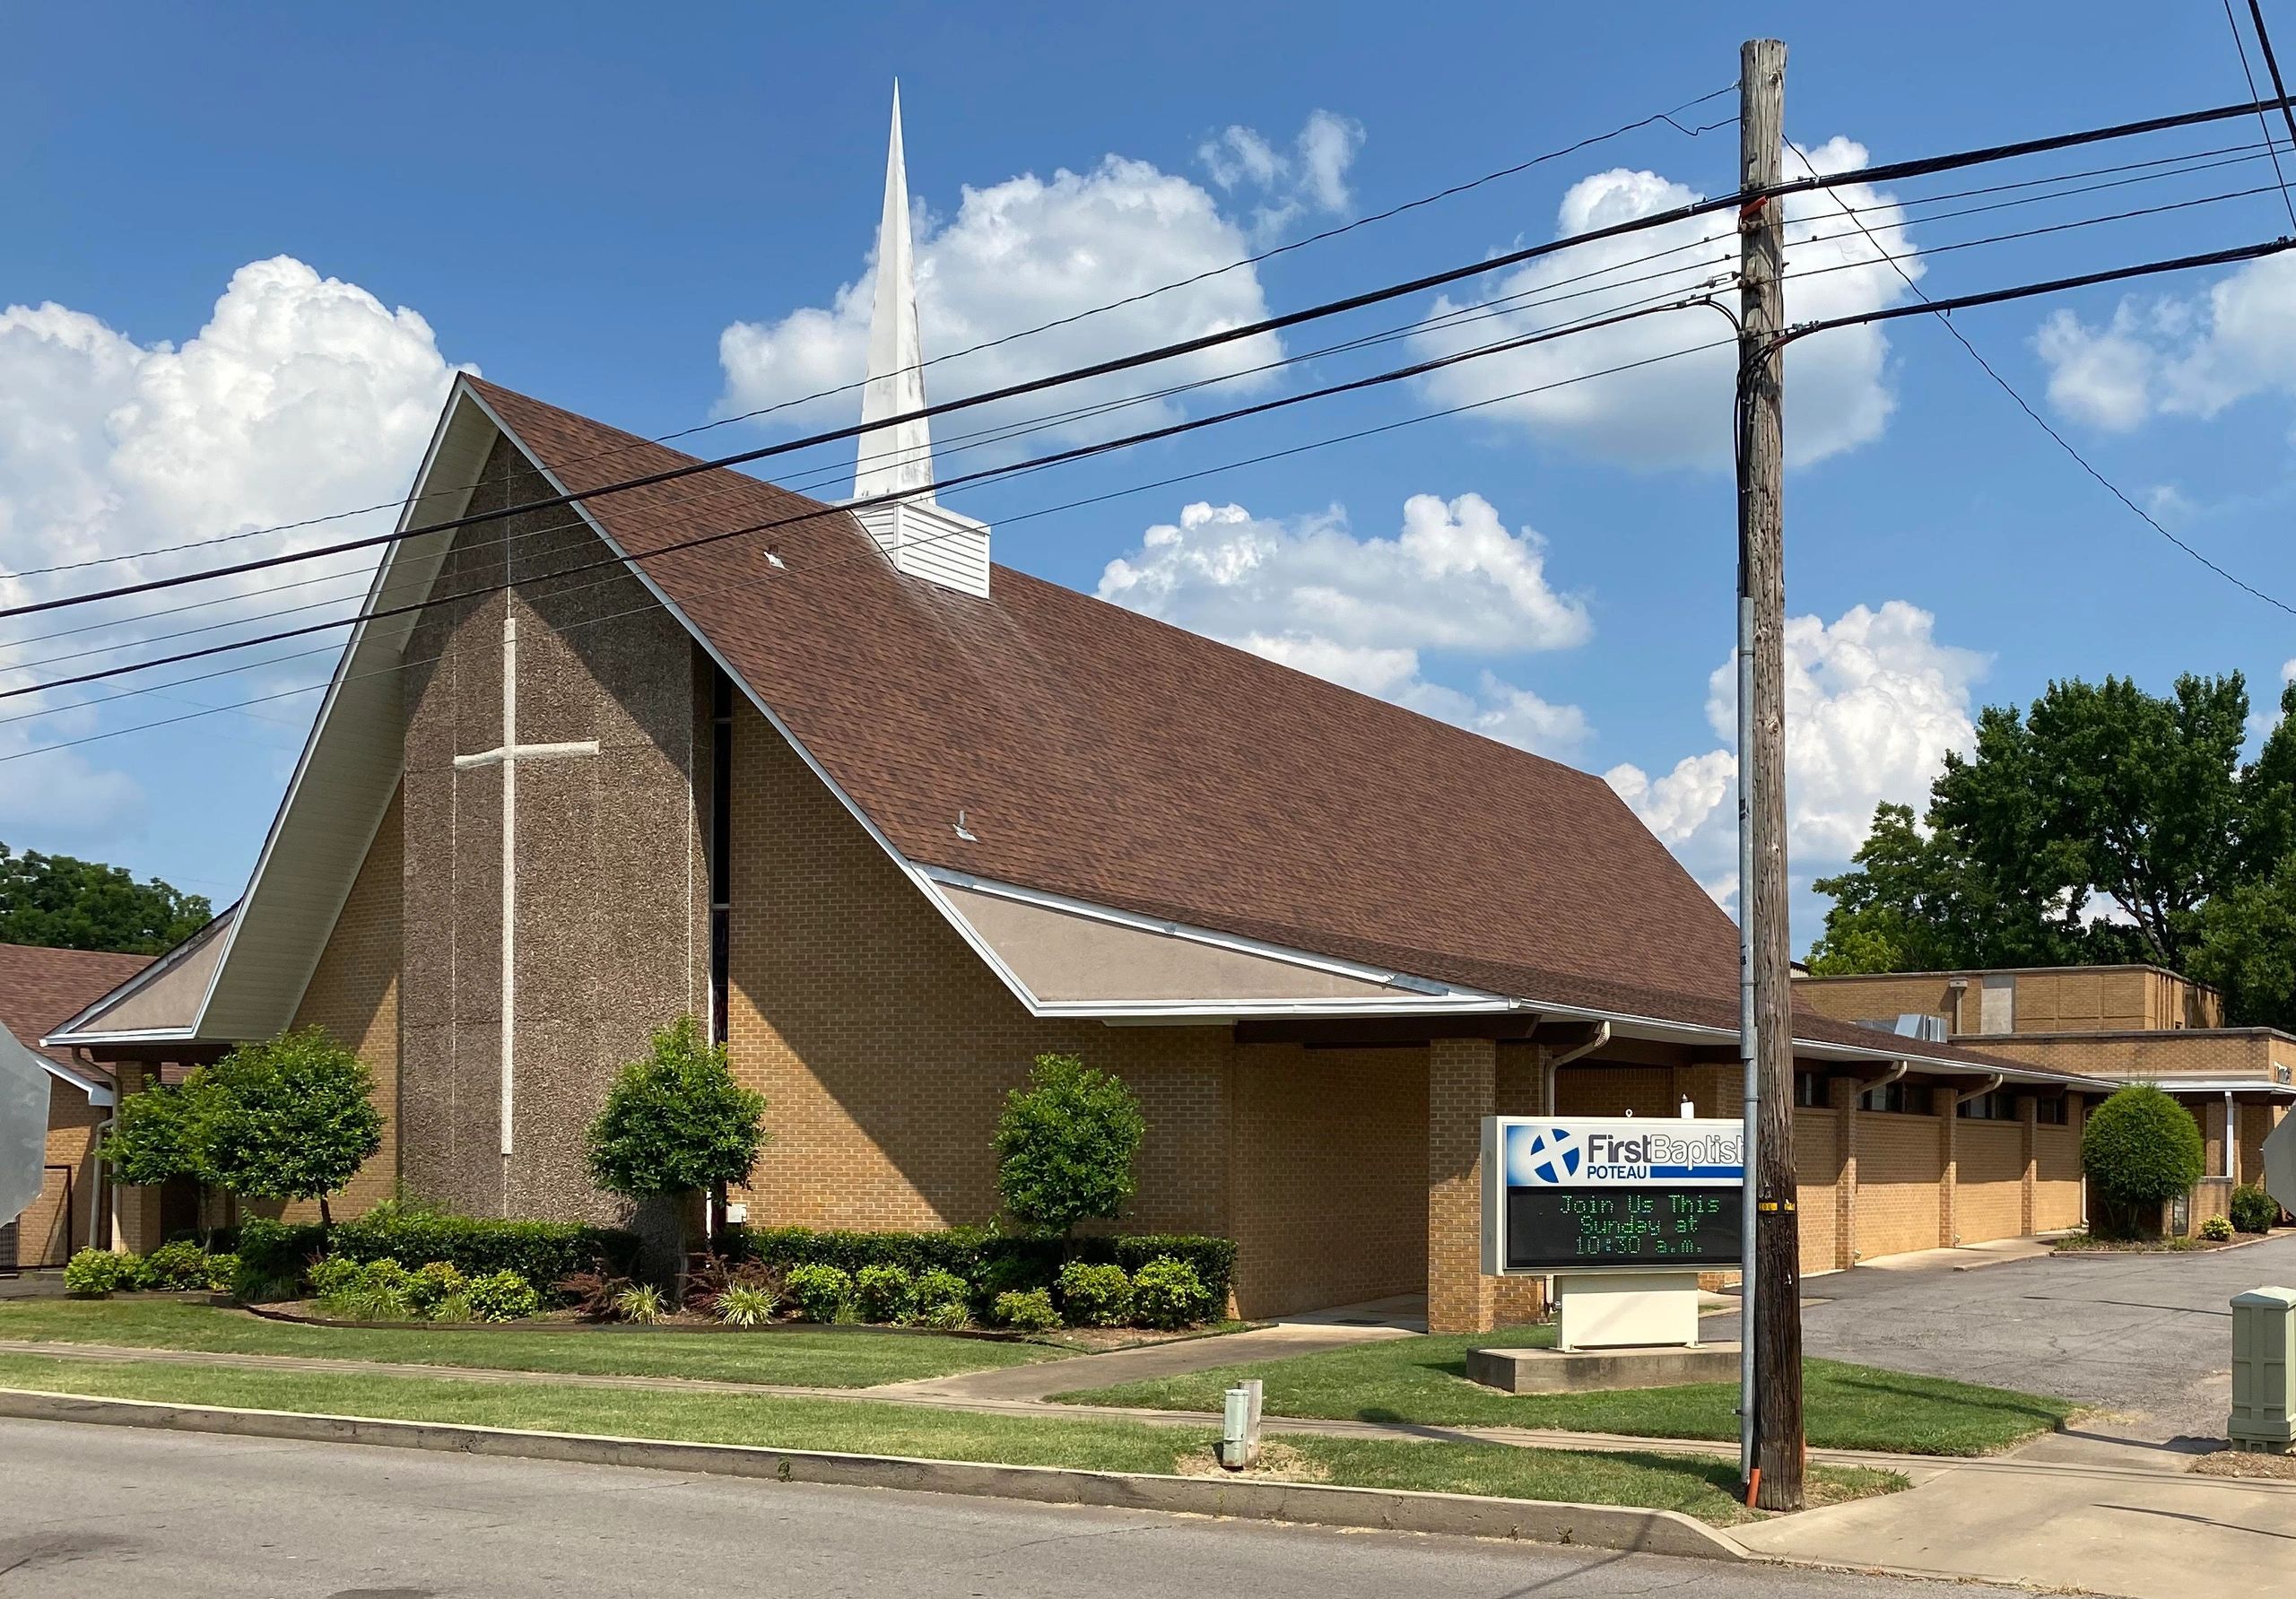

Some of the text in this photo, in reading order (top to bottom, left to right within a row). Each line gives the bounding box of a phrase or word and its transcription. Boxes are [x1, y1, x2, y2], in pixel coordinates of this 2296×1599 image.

[1587, 1134, 1744, 1171] FirstBaptist
[1587, 1165, 1648, 1179] POTEAU
[1560, 1195, 1720, 1213] Join Us This
[1580, 1214, 1698, 1236] Sunday at
[1576, 1236, 1641, 1255] 10:30
